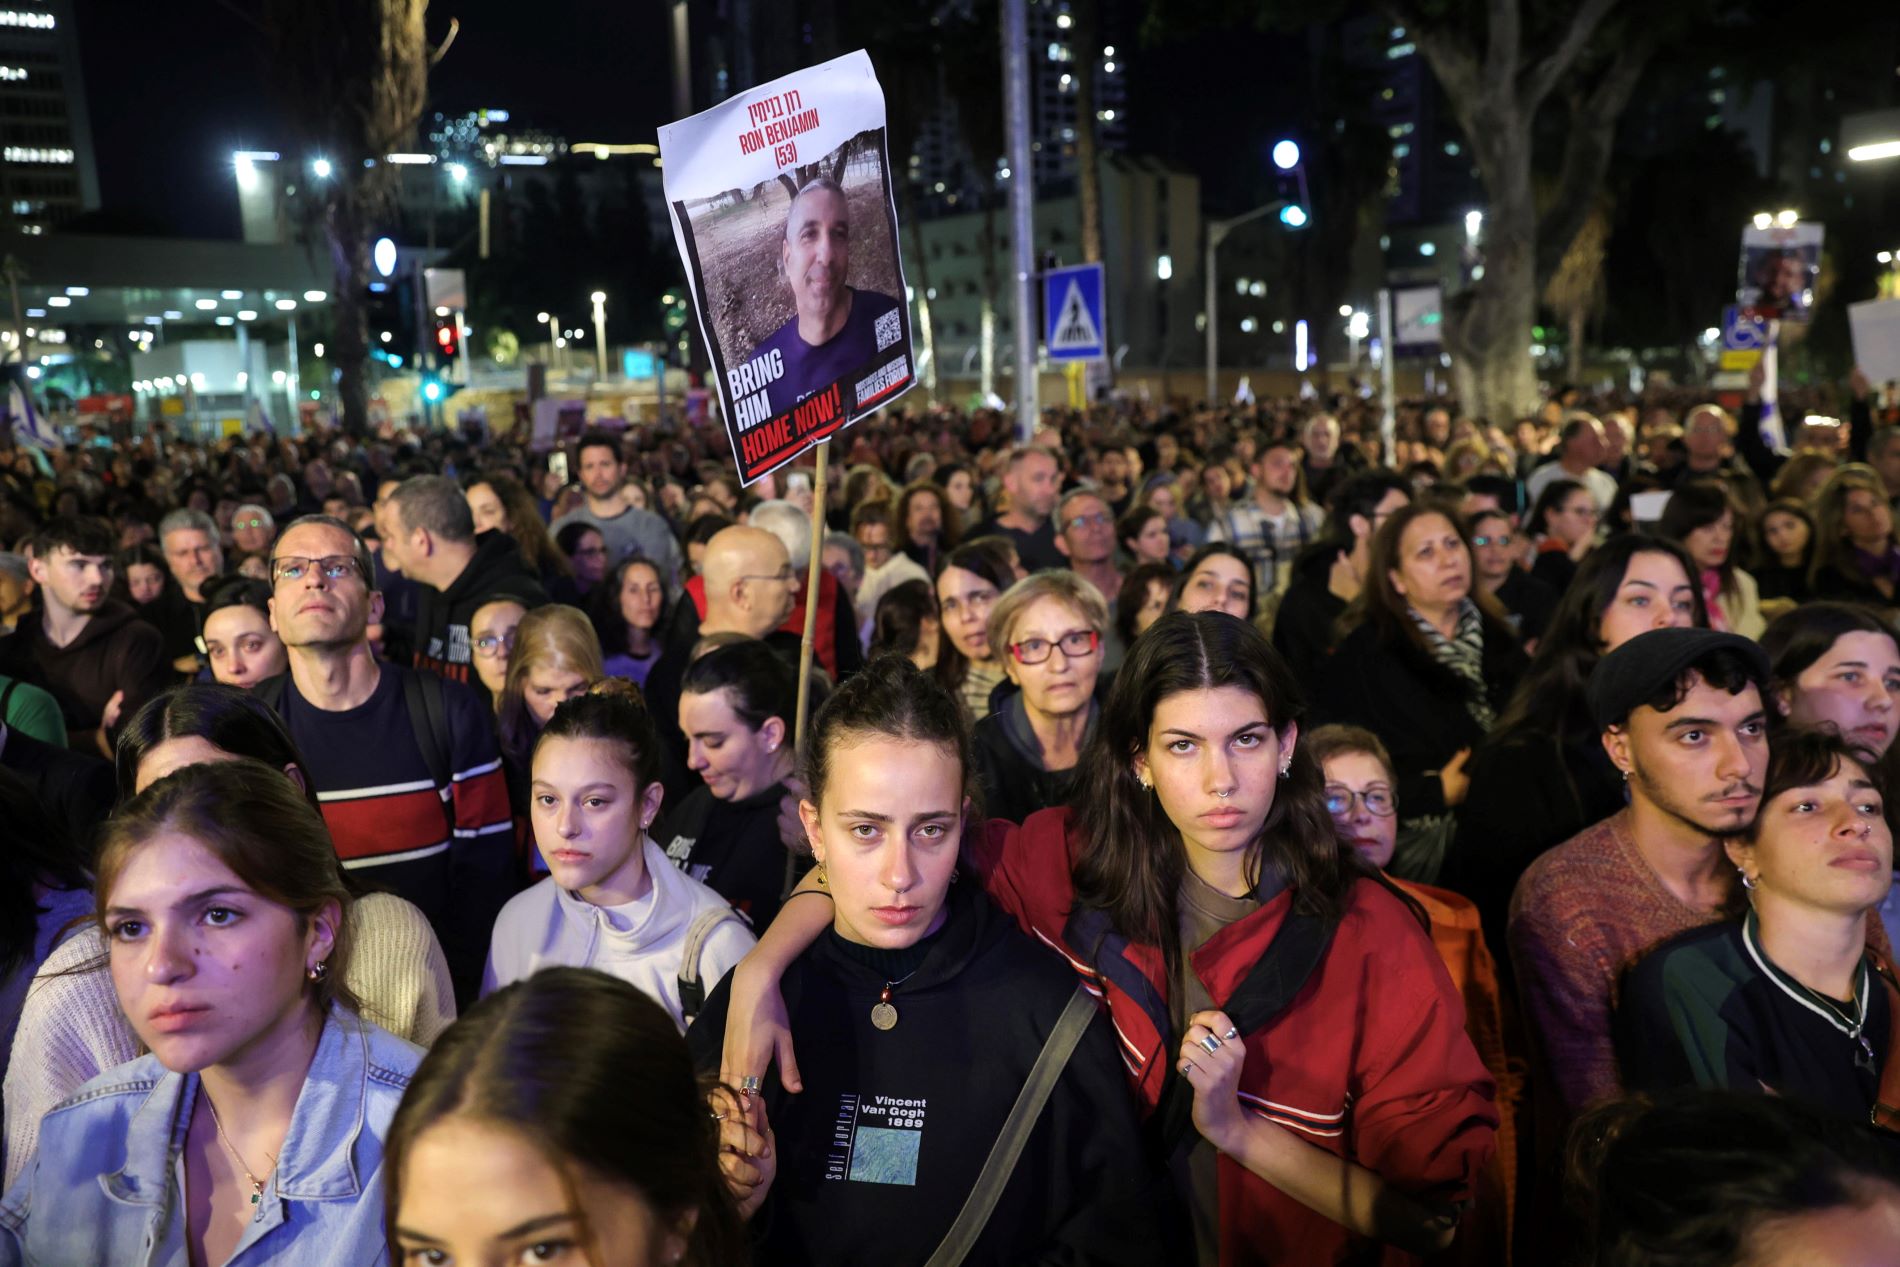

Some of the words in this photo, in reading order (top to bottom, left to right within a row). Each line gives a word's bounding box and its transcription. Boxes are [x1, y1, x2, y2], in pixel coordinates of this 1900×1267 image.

[747, 96, 784, 128] בנימין
[783, 90, 802, 116] רון
[739, 128, 766, 155] RON
[764, 107, 820, 146] BENJAMIN
[774, 140, 798, 170] (53)
[726, 348, 785, 402] BRING
[857, 375, 887, 406] FAMILIES
[884, 363, 910, 388] FORUM
[733, 388, 773, 433] HIM
[741, 413, 794, 465] HOME
[793, 382, 842, 437] NOW!
[861, 1104, 887, 1115] Van
[889, 1106, 926, 1119] Gogh
[875, 1095, 927, 1108] Vincent
[833, 1093, 857, 1148] portrait
[887, 1117, 924, 1128] 1889
[825, 1154, 846, 1180] Self
